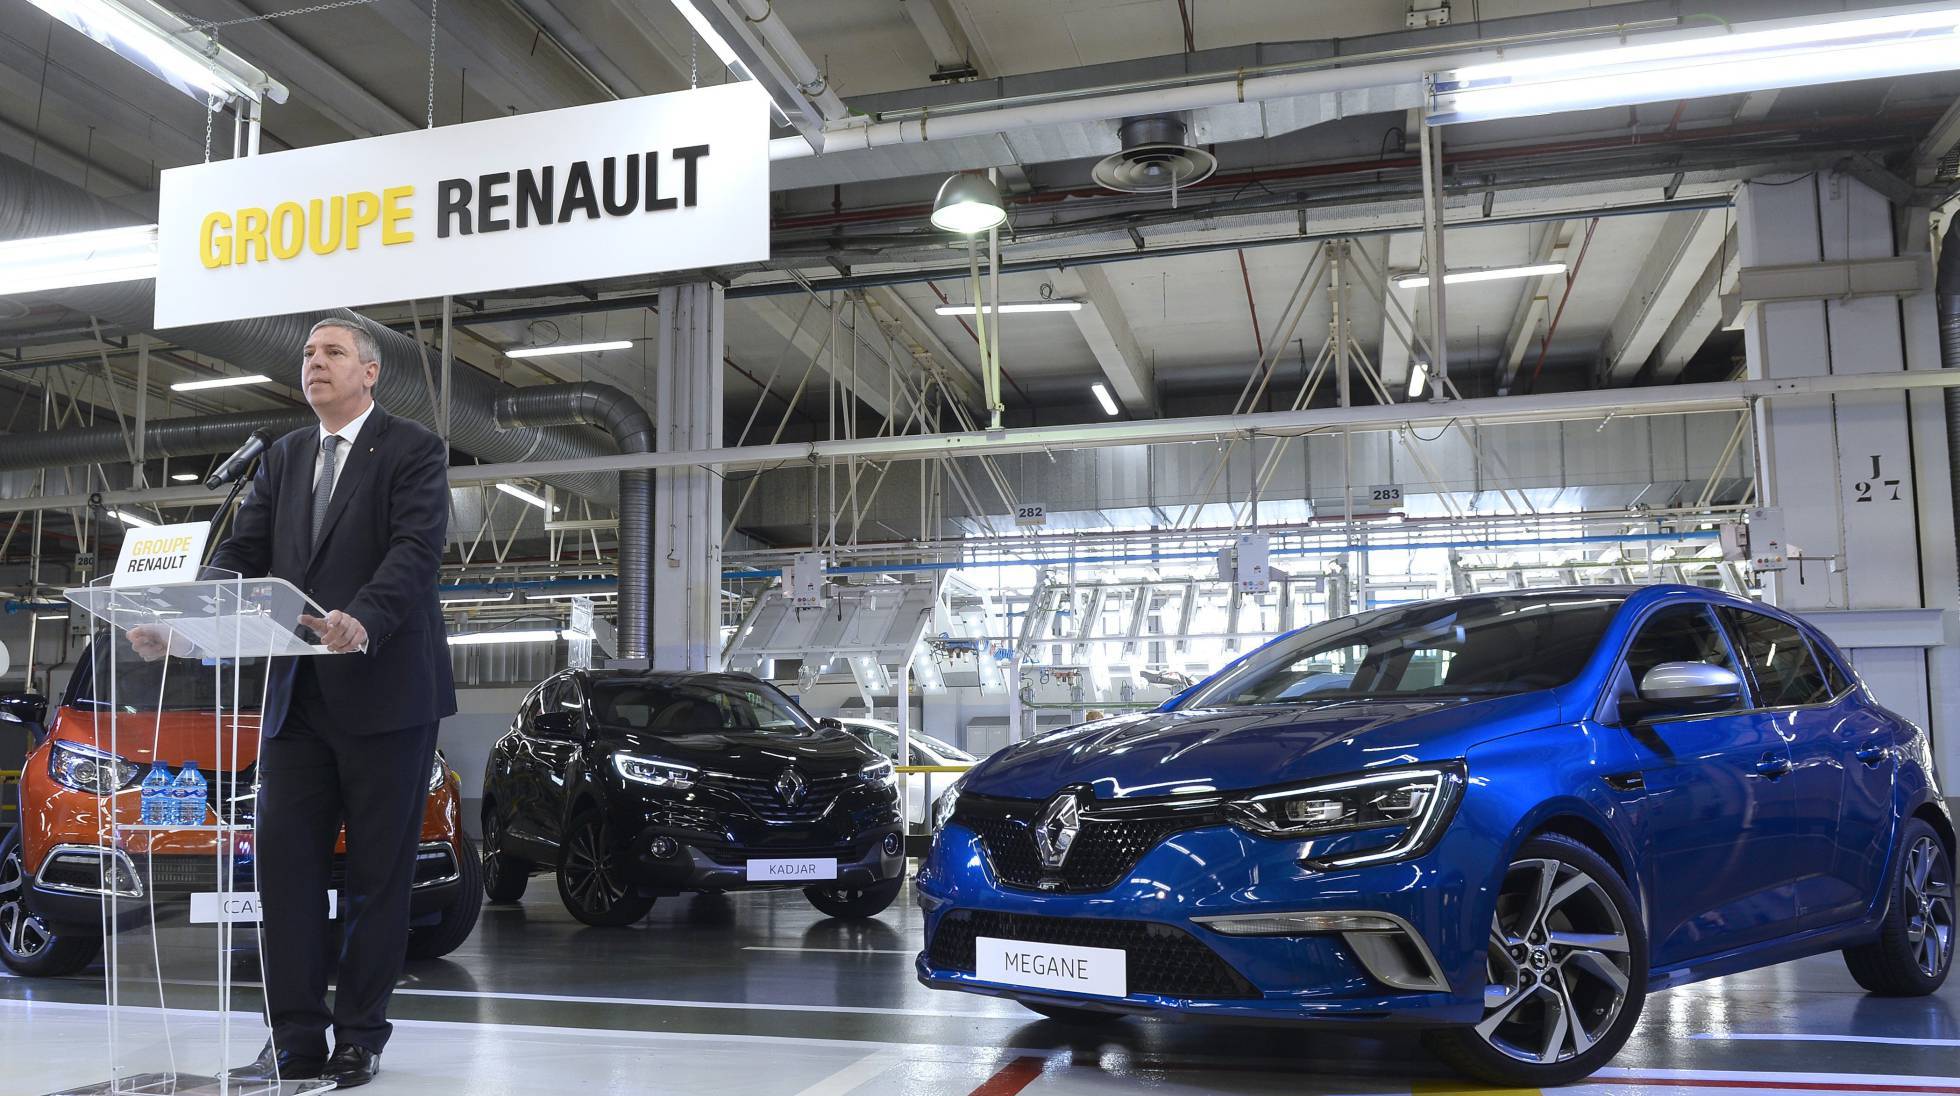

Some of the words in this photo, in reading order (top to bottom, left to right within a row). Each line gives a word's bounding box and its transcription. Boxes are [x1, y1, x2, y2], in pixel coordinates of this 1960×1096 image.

[199, 185, 415, 269] GROUPE
[437, 144, 710, 238] RENAULT
[1869, 454, 1882, 480] J
[1373, 489, 1400, 500] 283
[1019, 507, 1043, 518] 282
[132, 536, 192, 556] GROUPE
[127, 555, 187, 573] RENAULT
[769, 864, 816, 875] KADJAR
[1005, 951, 1089, 980] MEGANE
